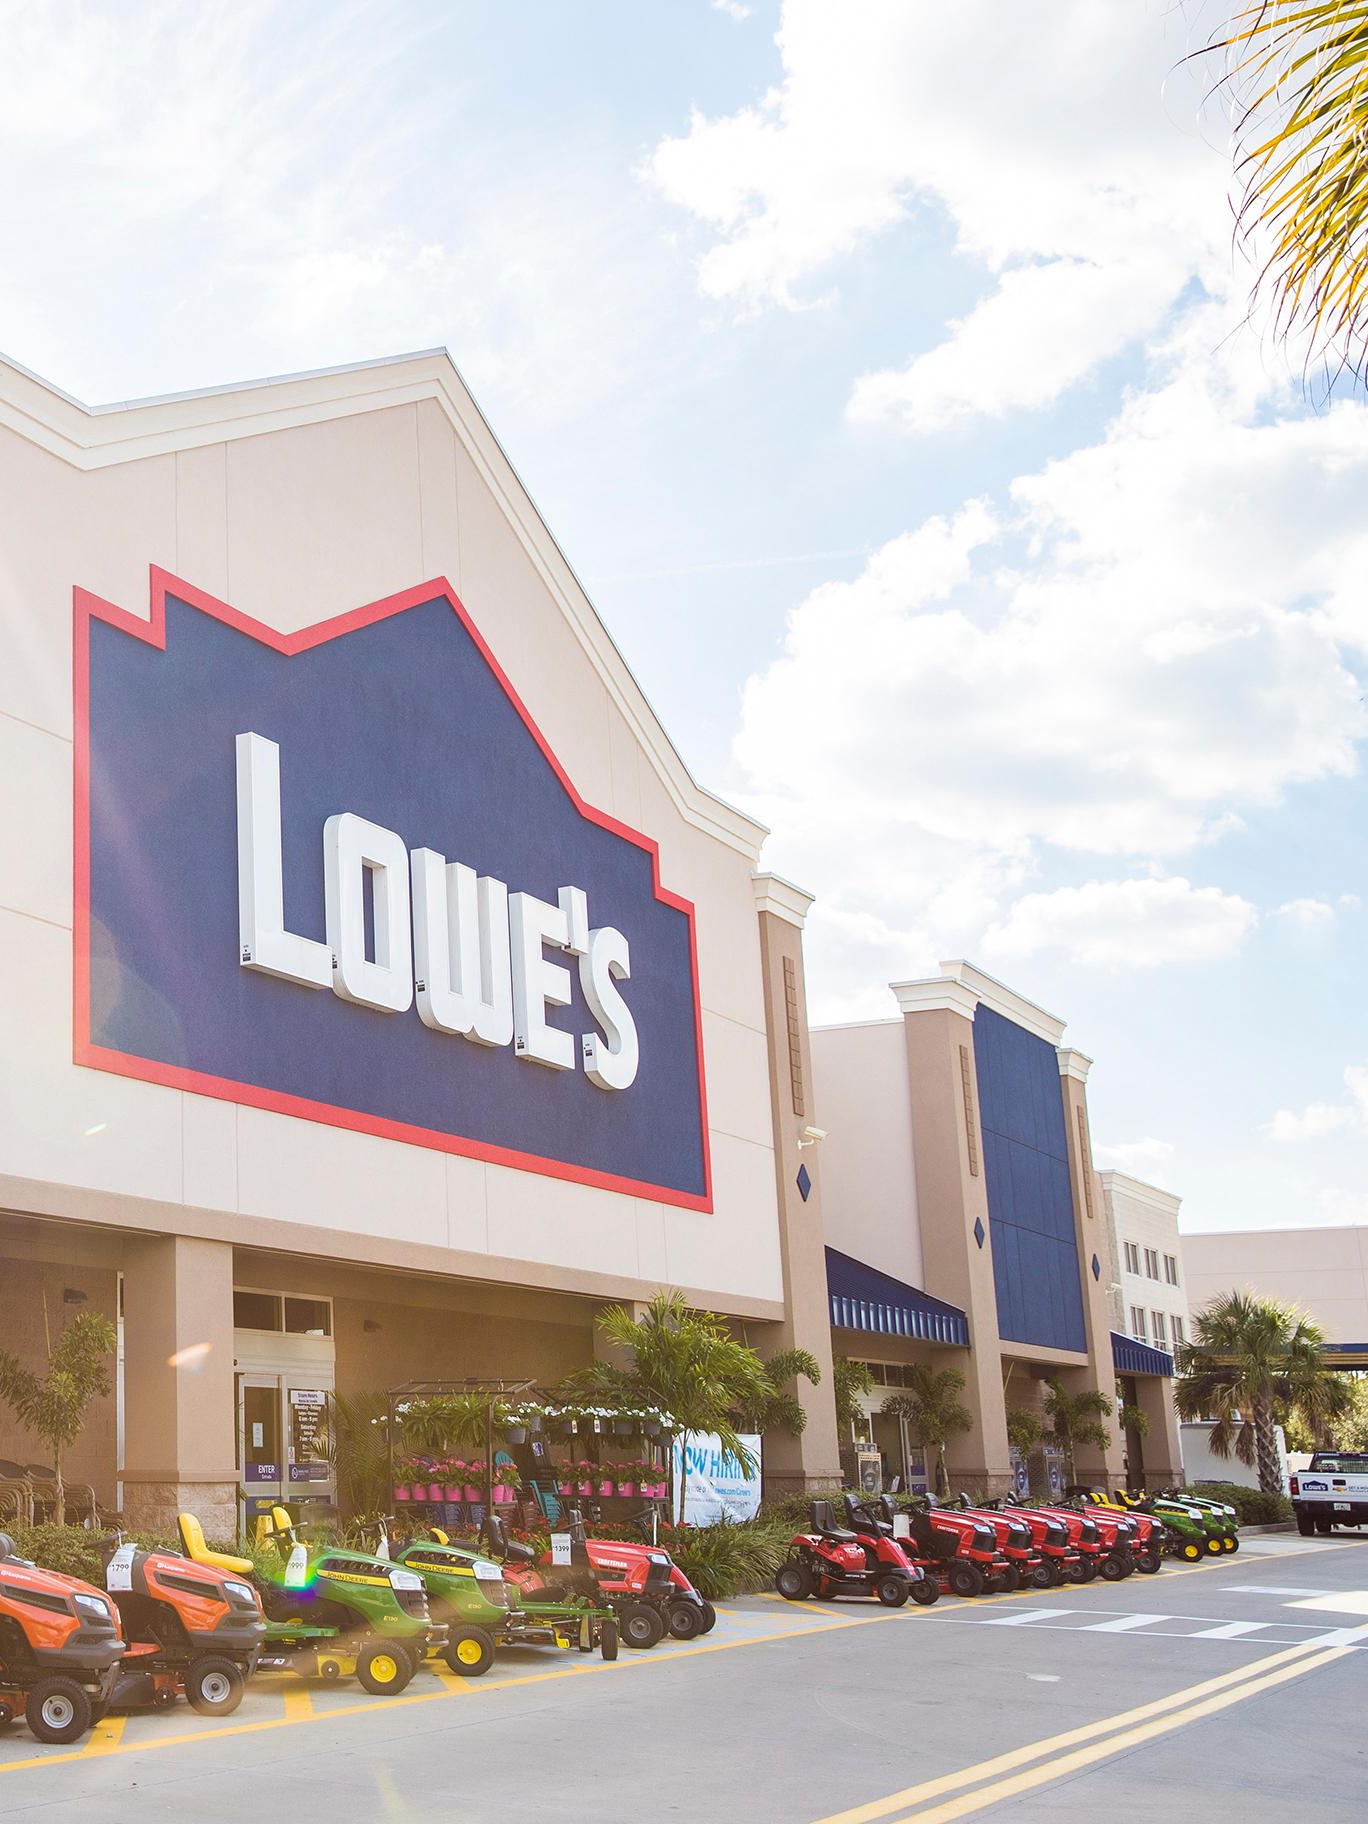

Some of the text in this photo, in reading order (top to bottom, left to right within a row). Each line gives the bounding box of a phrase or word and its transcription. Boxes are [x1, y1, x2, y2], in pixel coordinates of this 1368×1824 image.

[236, 732, 639, 1091] LOWE'S
[674, 1444, 708, 1475] NOW
[258, 1464, 276, 1474] ENTER
[416, 1563, 455, 1574] JOHN DEERE
[327, 1571, 368, 1584] JOHN DEERE
